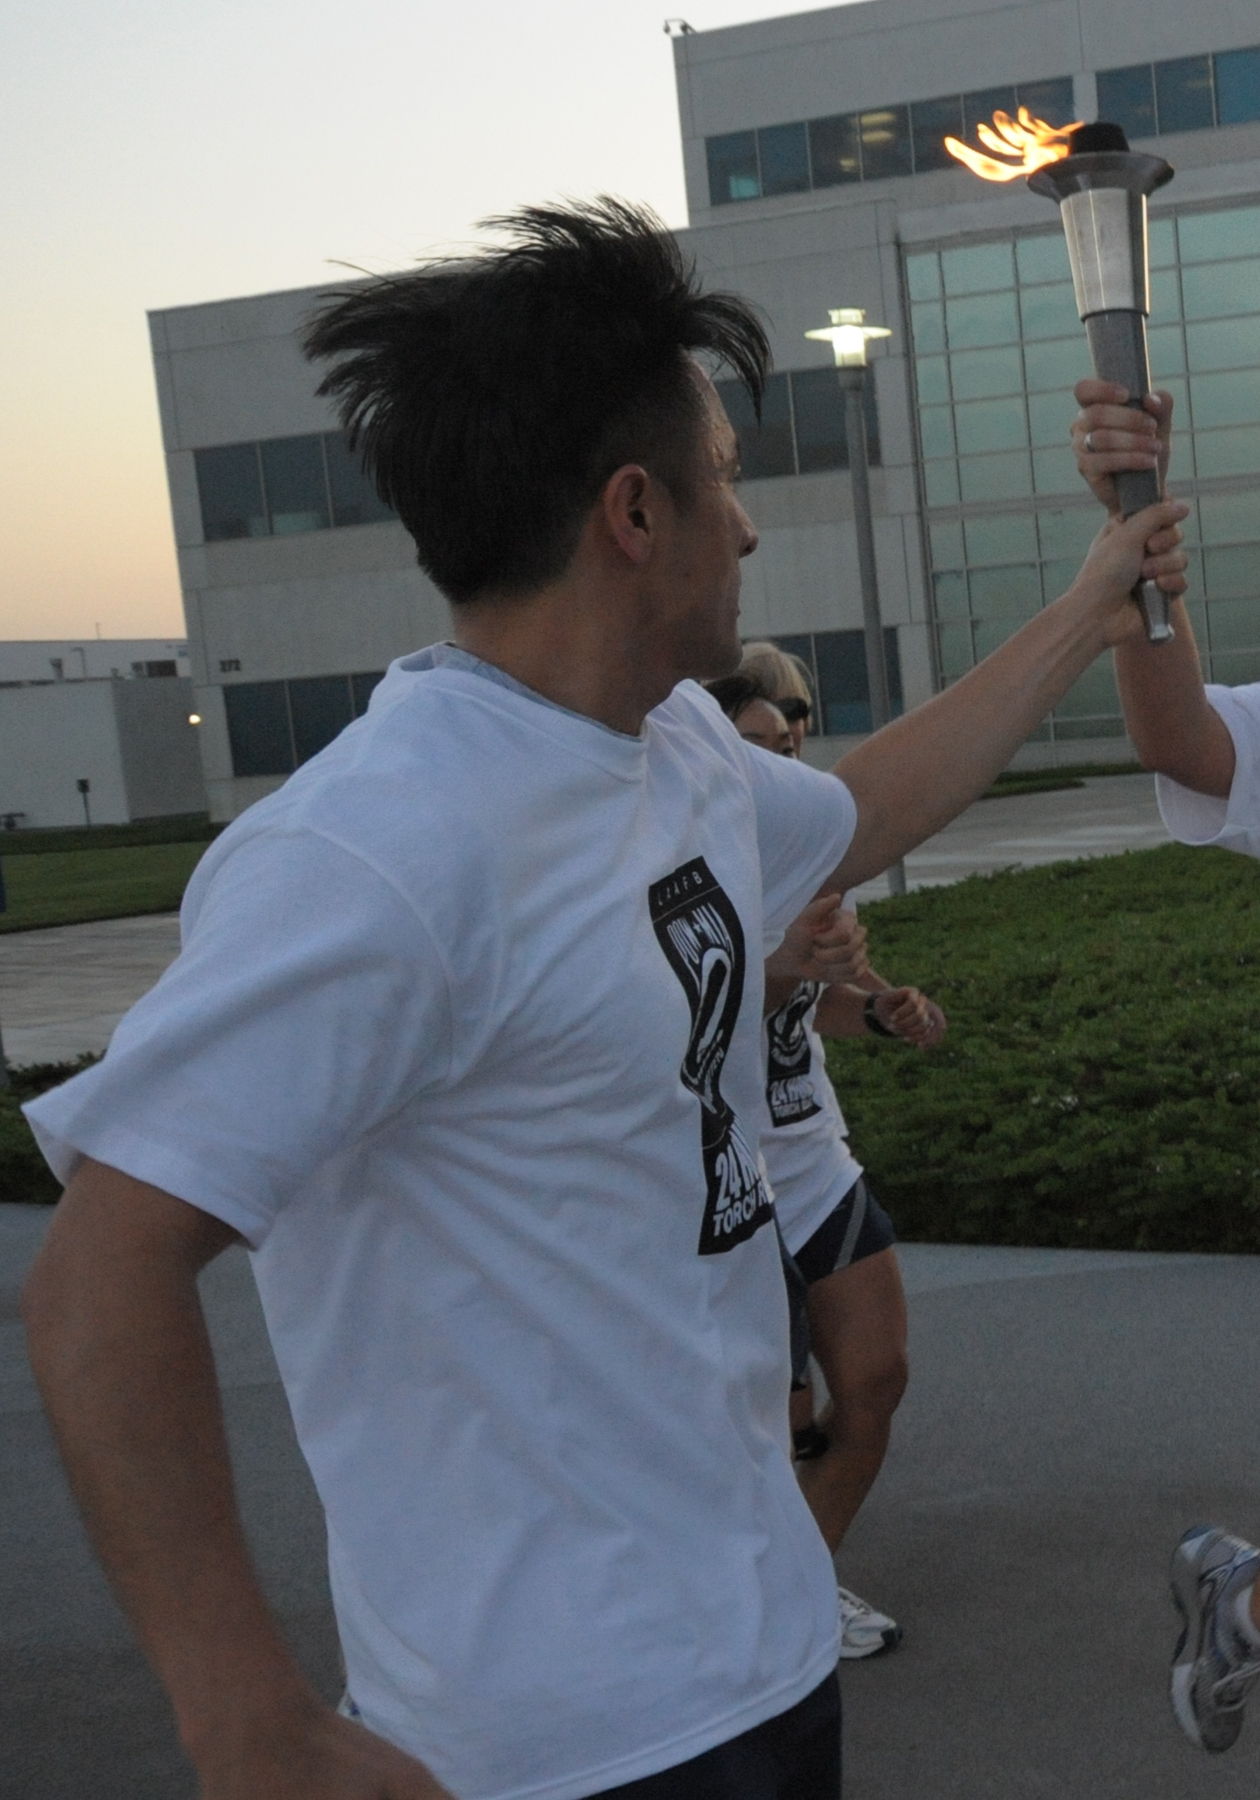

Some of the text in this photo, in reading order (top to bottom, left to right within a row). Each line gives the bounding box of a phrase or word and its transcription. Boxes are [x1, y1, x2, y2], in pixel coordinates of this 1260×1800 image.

[691, 902, 735, 969] MIA
[715, 1144, 742, 1212] 24
[713, 1189, 757, 1237] TORCH
